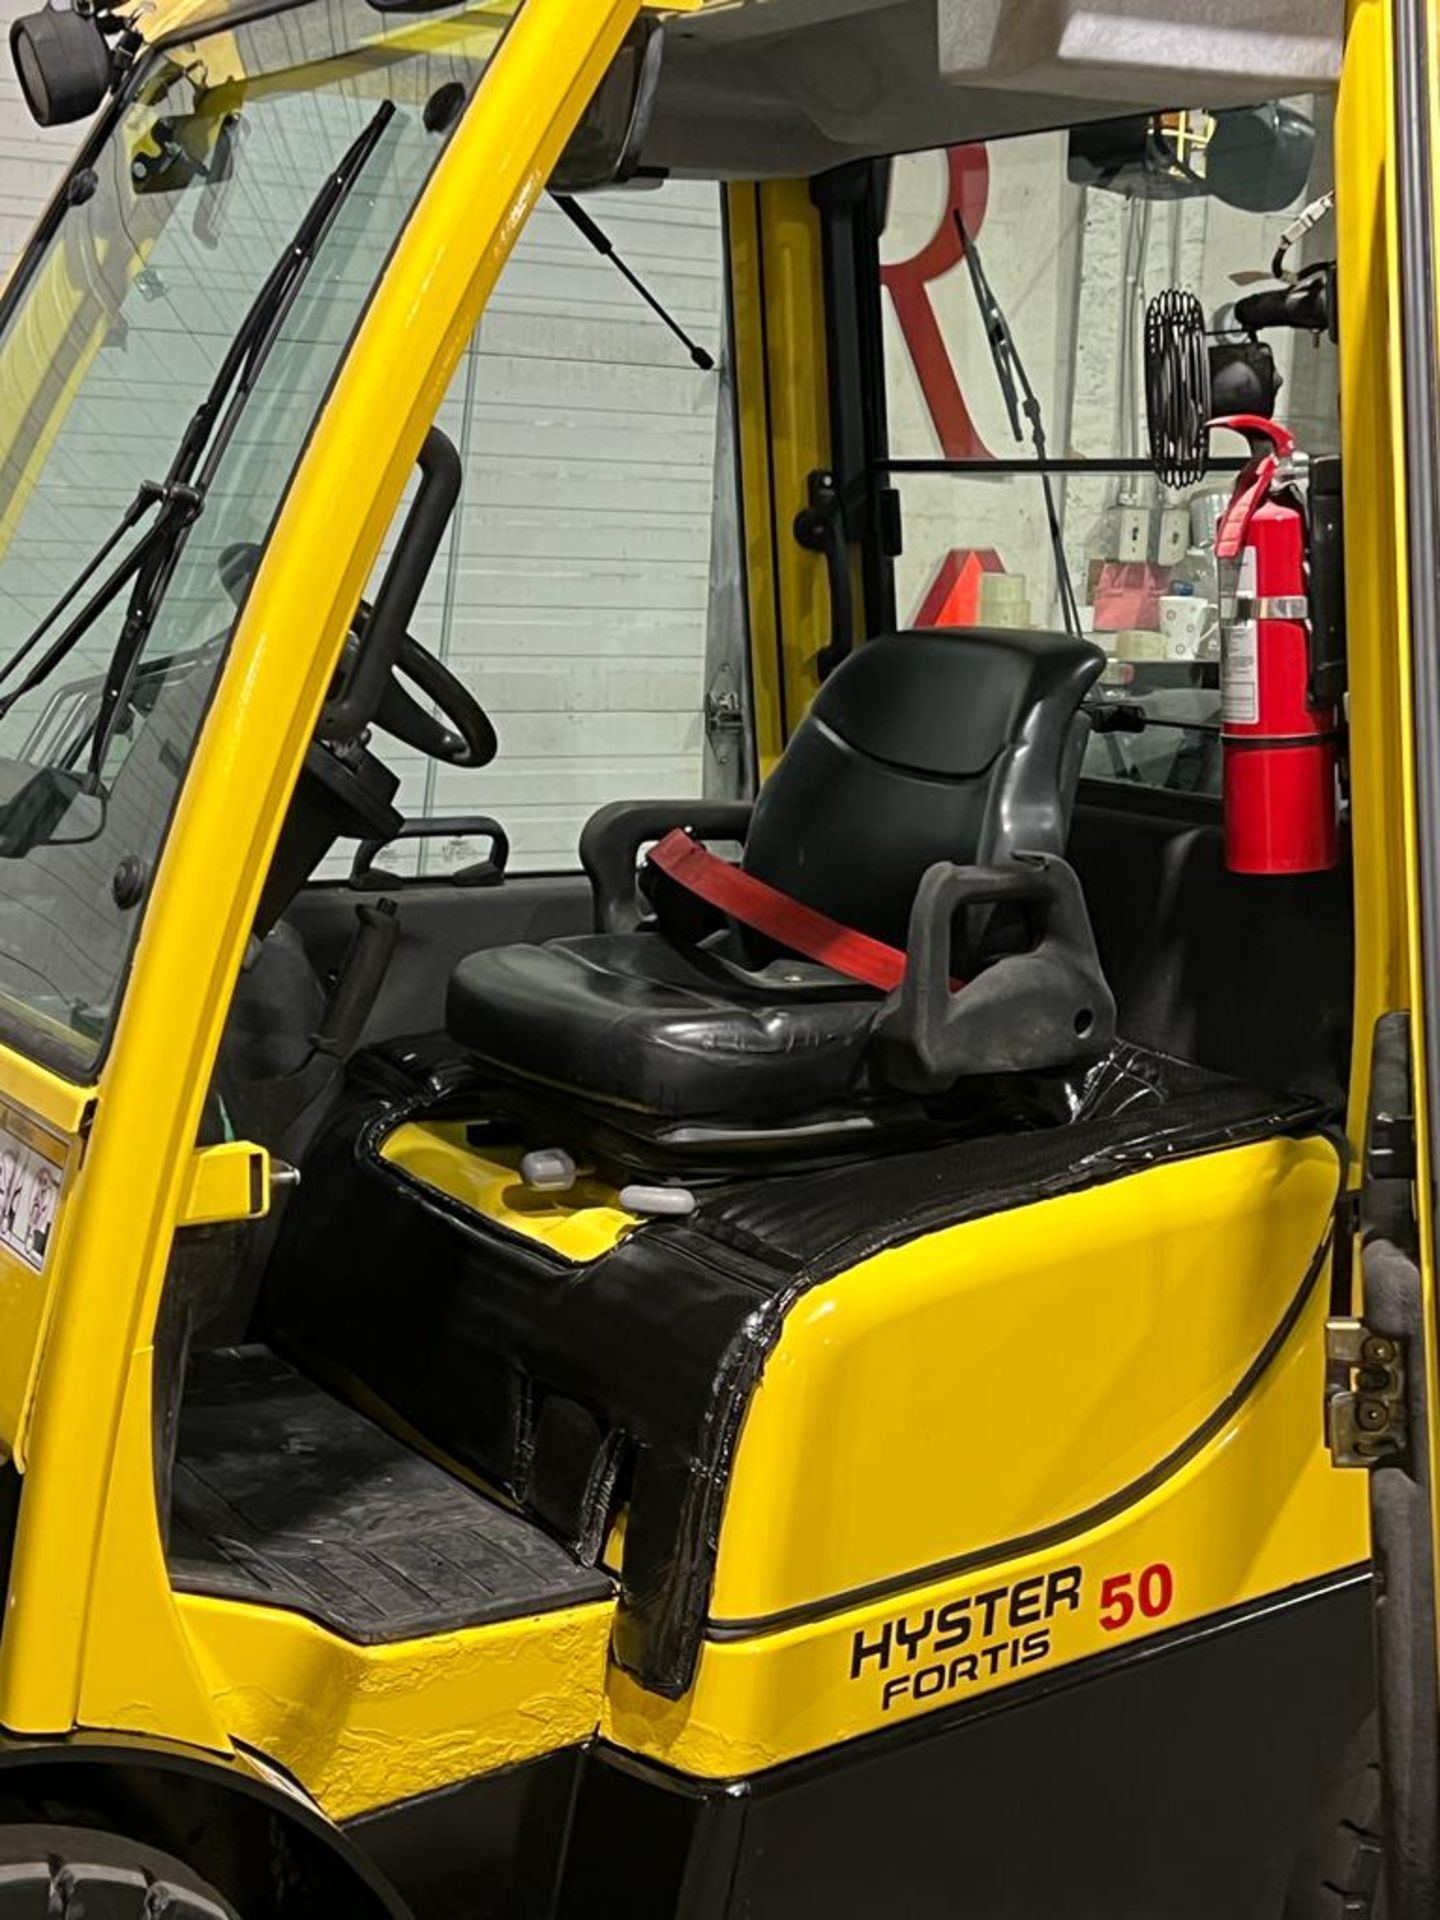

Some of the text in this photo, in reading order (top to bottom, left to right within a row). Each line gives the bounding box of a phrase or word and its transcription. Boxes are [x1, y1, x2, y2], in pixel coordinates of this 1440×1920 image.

[850, 1563, 1173, 1679] HYSTER 50
[882, 1628, 1050, 1711] FORTIS
